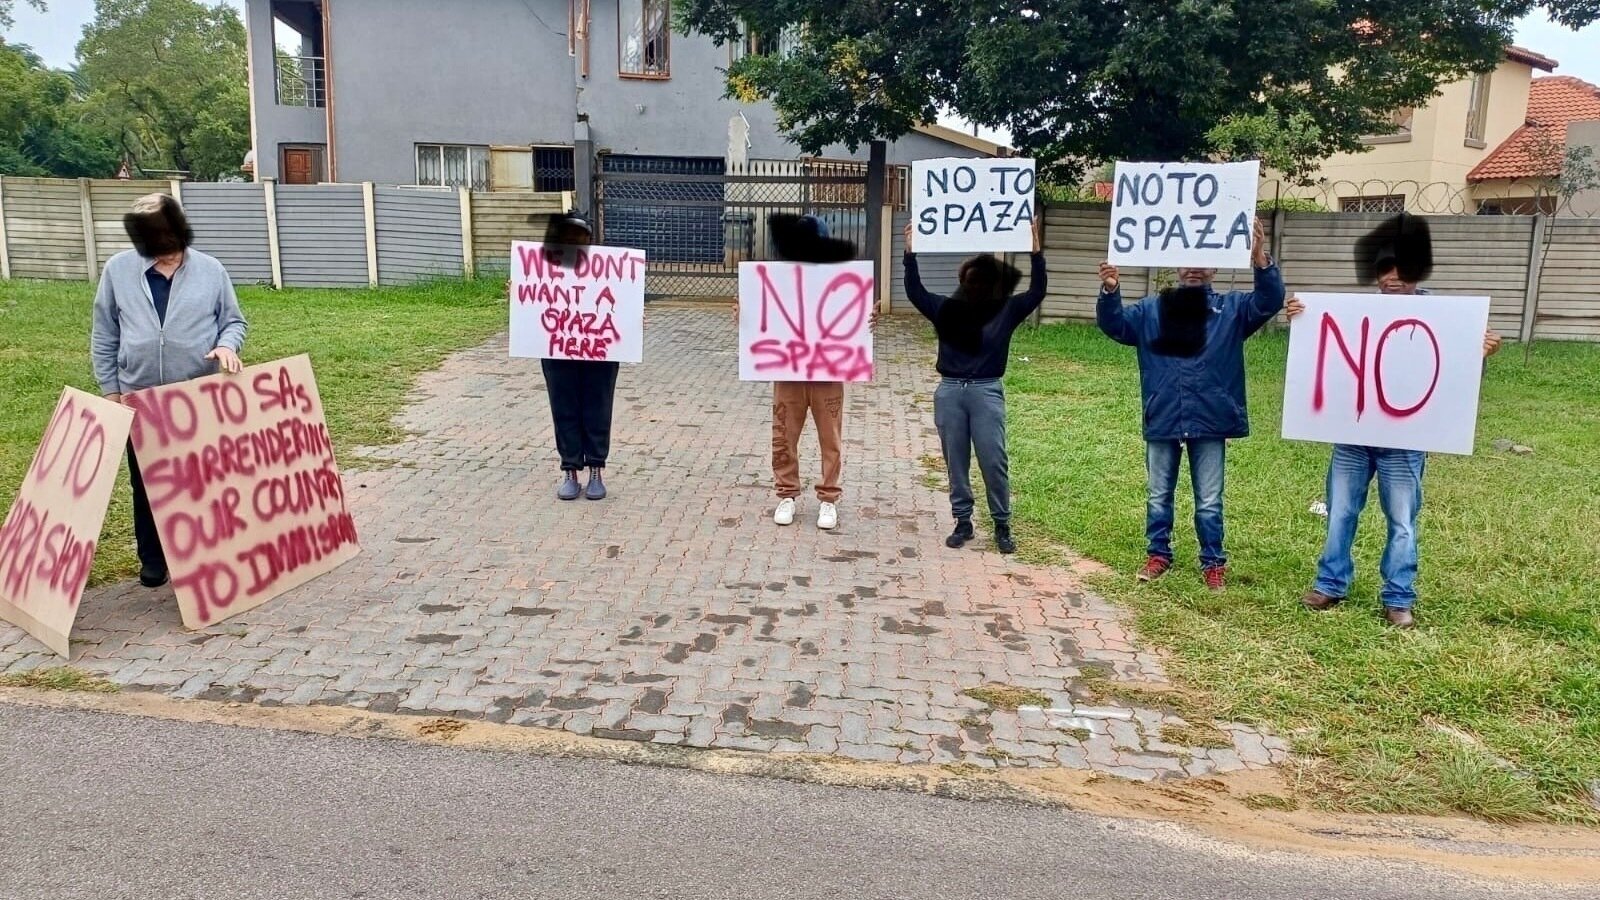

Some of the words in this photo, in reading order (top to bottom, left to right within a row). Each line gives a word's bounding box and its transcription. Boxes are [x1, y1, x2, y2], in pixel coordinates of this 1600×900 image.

[926, 166, 976, 197] NO
[989, 167, 1035, 195] TO
[1116, 172, 1163, 207] NO
[1166, 172, 1219, 207] TO
[918, 199, 1034, 235] SPAZA
[1113, 211, 1251, 253] SPAZA
[517, 245, 565, 282] WE
[574, 249, 645, 282] DON'T
[518, 283, 586, 307] WANT
[595, 286, 616, 311] A
[541, 308, 620, 341] SPAZA
[549, 333, 612, 359] HERE
[750, 339, 873, 381] SPAZA
[1313, 312, 1440, 421] NO
[122, 387, 198, 450] NO
[199, 381, 248, 424] TO
[31, 392, 75, 483] O
[62, 408, 105, 498] TO
[164, 487, 248, 561] OUR
[36, 523, 94, 605] SHOP
[172, 562, 239, 622] TO
